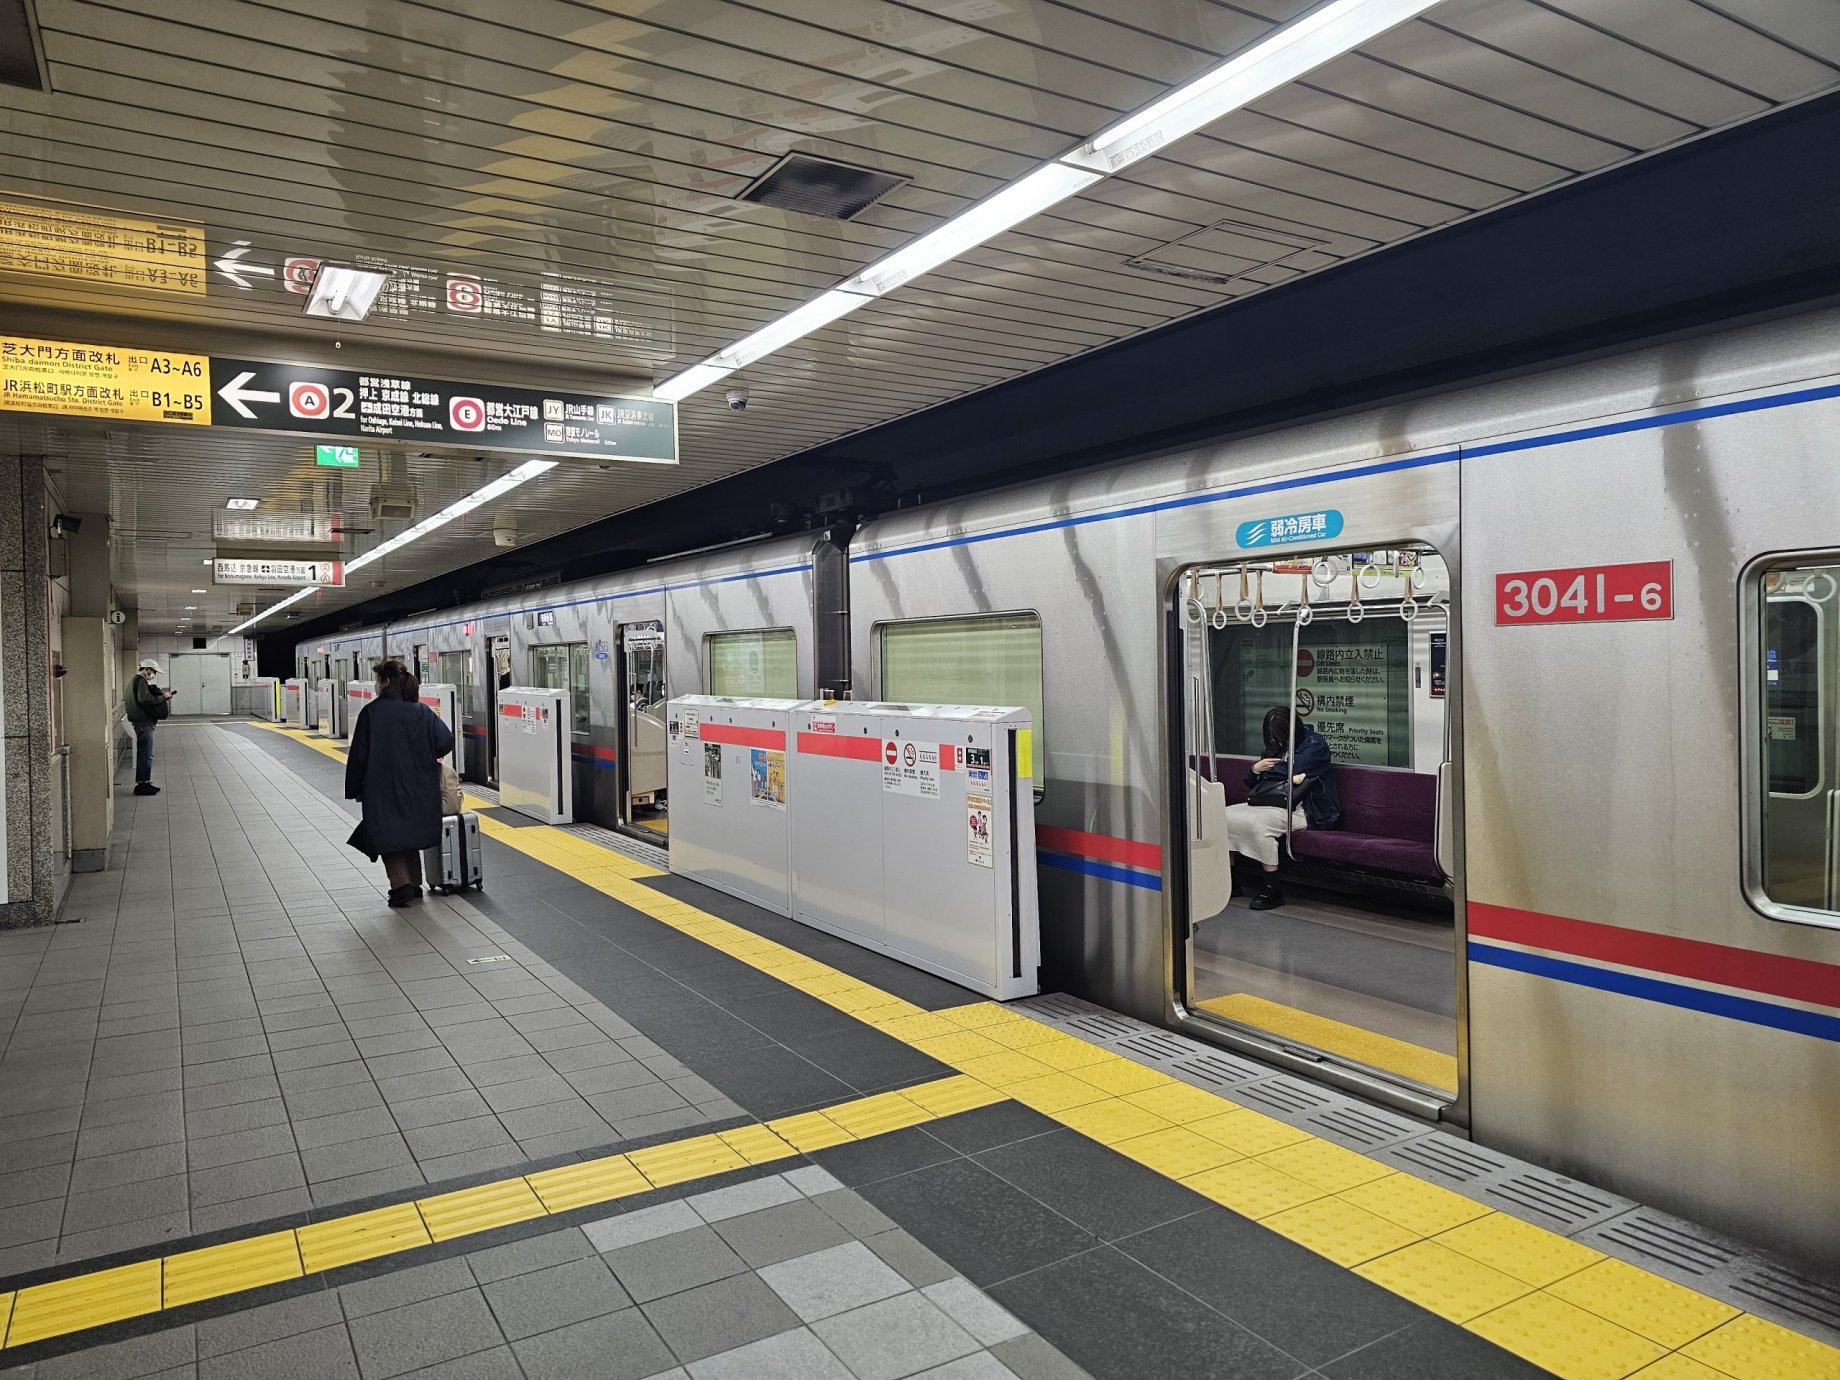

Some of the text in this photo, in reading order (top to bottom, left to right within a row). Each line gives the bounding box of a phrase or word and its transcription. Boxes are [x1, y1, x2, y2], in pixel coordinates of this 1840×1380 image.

[2, 342, 148, 365] 芝大門方面改札 出口
[2, 355, 113, 372] Shiba daimon District Gate
[150, 357, 202, 377] A3~A6
[3, 379, 149, 401] JR浜松町駅方面改札 出口
[359, 386, 379, 400] 押上
[381, 388, 410, 403] 京成線
[82, 397, 106, 406] District
[107, 399, 124, 407] Gate
[151, 391, 203, 410] B1~B5
[304, 395, 316, 406] A
[333, 387, 356, 419] 2
[464, 409, 471, 419] E
[486, 401, 539, 420] 都営大江戸線
[548, 405, 560, 415] JY
[564, 403, 595, 416] JR山手線
[600, 410, 613, 420] JK
[486, 416, 528, 427] Oedo Line
[547, 428, 562, 438] MO
[1270, 513, 1327, 538] 弱冷房車
[1281, 533, 1317, 542] Air-Conditioned
[308, 564, 317, 581] 1
[1502, 573, 1663, 617] 3041-6
[1316, 648, 1384, 661] 線路内立入禁止
[1316, 694, 1355, 708] 構内禁煙
[1325, 707, 1348, 715] Smoking
[1317, 720, 1345, 733] 優先席
[1348, 727, 1369, 736] Priority
